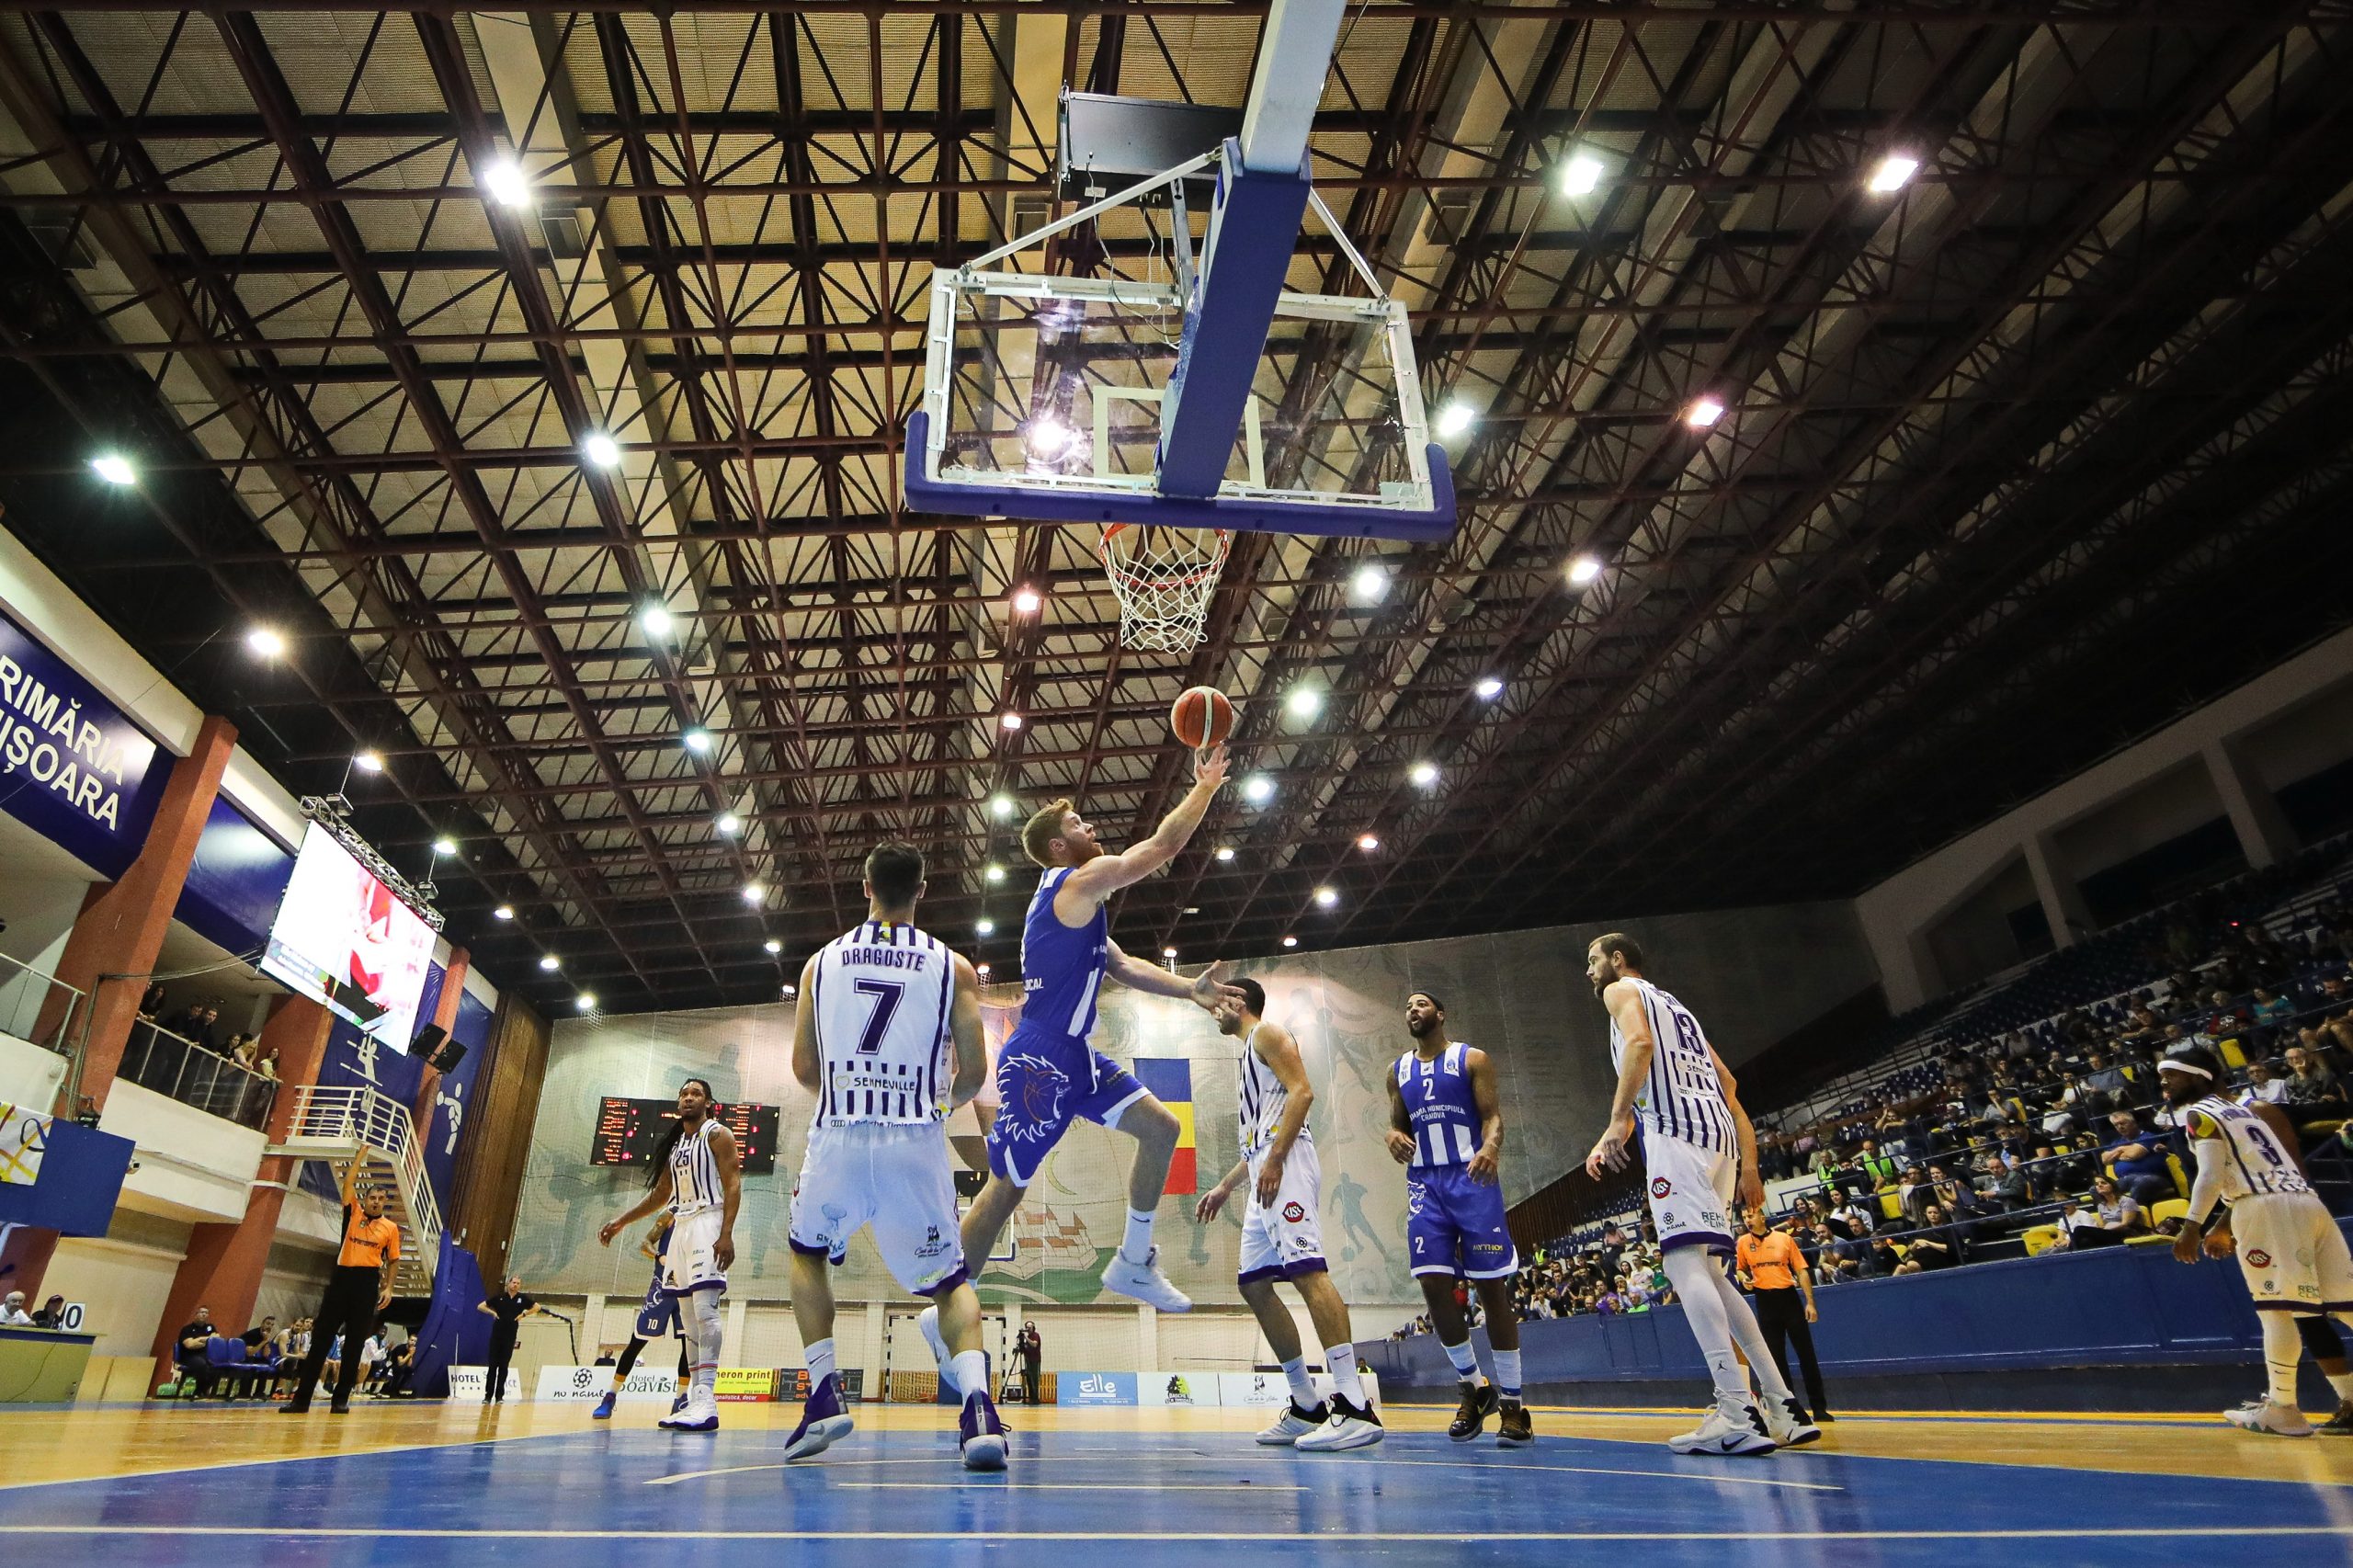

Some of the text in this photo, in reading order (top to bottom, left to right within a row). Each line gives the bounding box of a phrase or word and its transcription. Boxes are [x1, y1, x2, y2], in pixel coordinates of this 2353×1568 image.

[0, 709, 119, 832] IȘOARA
[841, 947, 926, 972] DRAGOSTE
[854, 977, 905, 1056] 7
[1422, 1077, 1436, 1101] 2
[2245, 1124, 2285, 1169] 3
[675, 1149, 690, 1167] 25
[1415, 1236, 1425, 1255] 2
[65, 1305, 83, 1330] 0
[647, 1318, 658, 1330] 10
[451, 1374, 481, 1383] HOTEL
[746, 1370, 770, 1381] print
[1079, 1373, 1117, 1393] Elle
